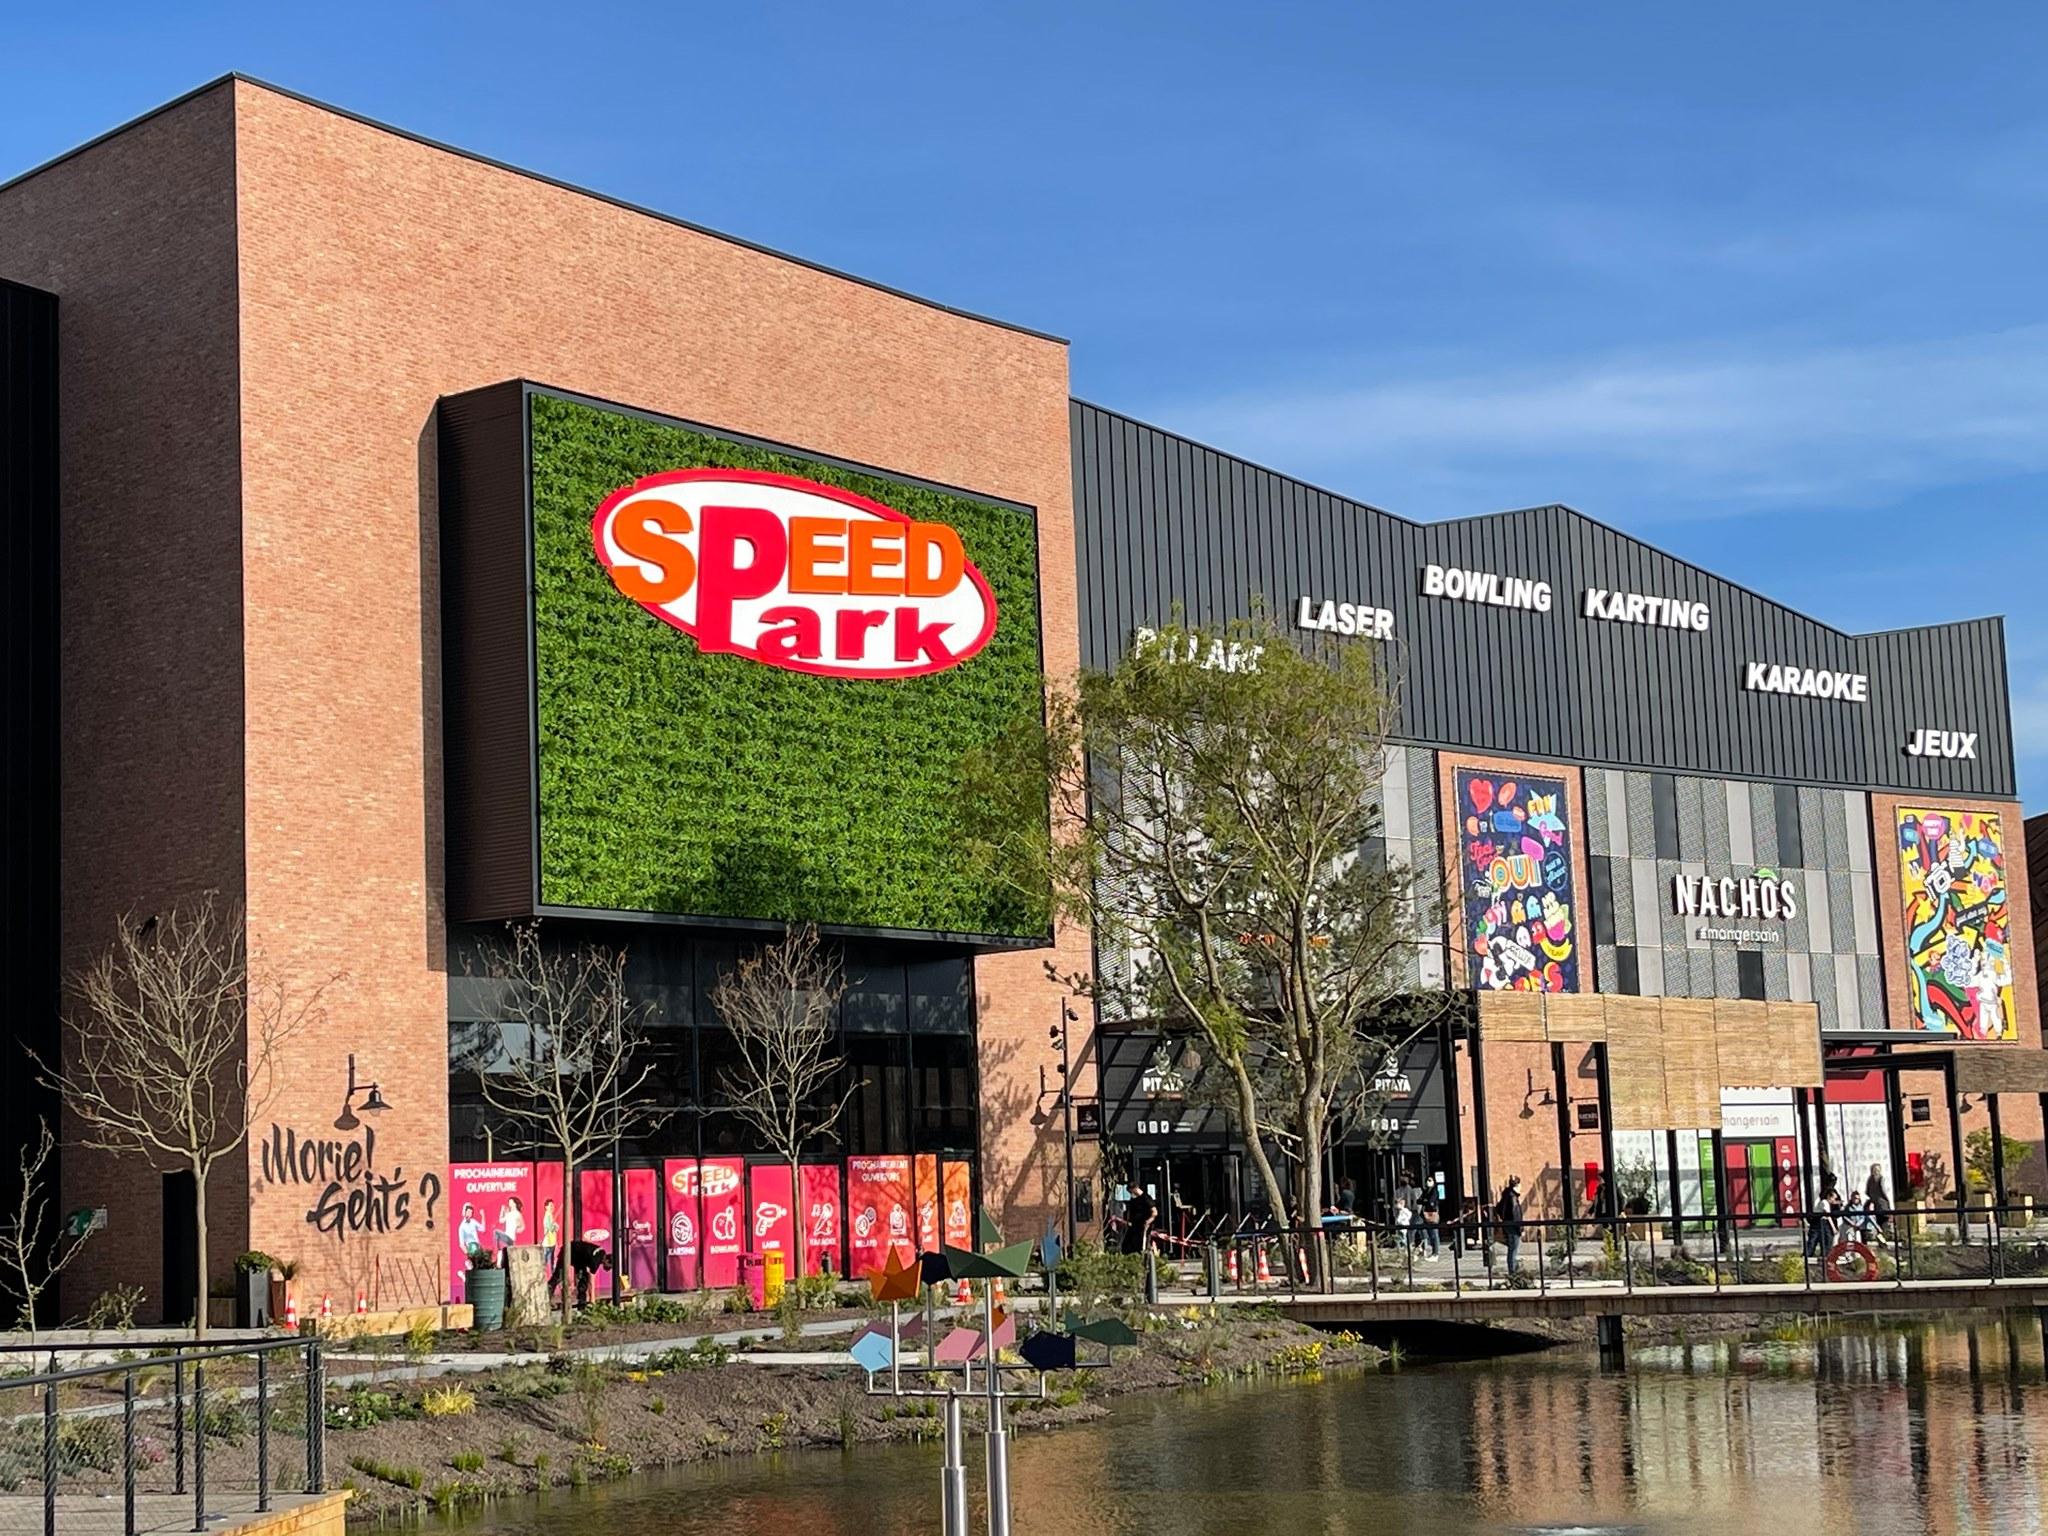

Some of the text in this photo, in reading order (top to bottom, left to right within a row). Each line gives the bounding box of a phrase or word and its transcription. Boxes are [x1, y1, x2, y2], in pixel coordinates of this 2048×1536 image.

[611, 500, 966, 652] SPEED
[1423, 564, 1552, 612] BOWLING
[1299, 596, 1394, 641] LASER
[1584, 587, 1710, 632] KARTING
[1746, 661, 1868, 703] KARAOKE
[1906, 728, 1978, 760] JEUX
[1489, 854, 1542, 892] OUI
[1674, 873, 1797, 920] NACHOS
[1374, 1078, 1412, 1092] PITAYA
[262, 1122, 375, 1185] Morie!
[454, 1167, 528, 1179] PROCHAINEMENT
[466, 1181, 517, 1193] OUVERTURE
[674, 1167, 733, 1195] SPEED
